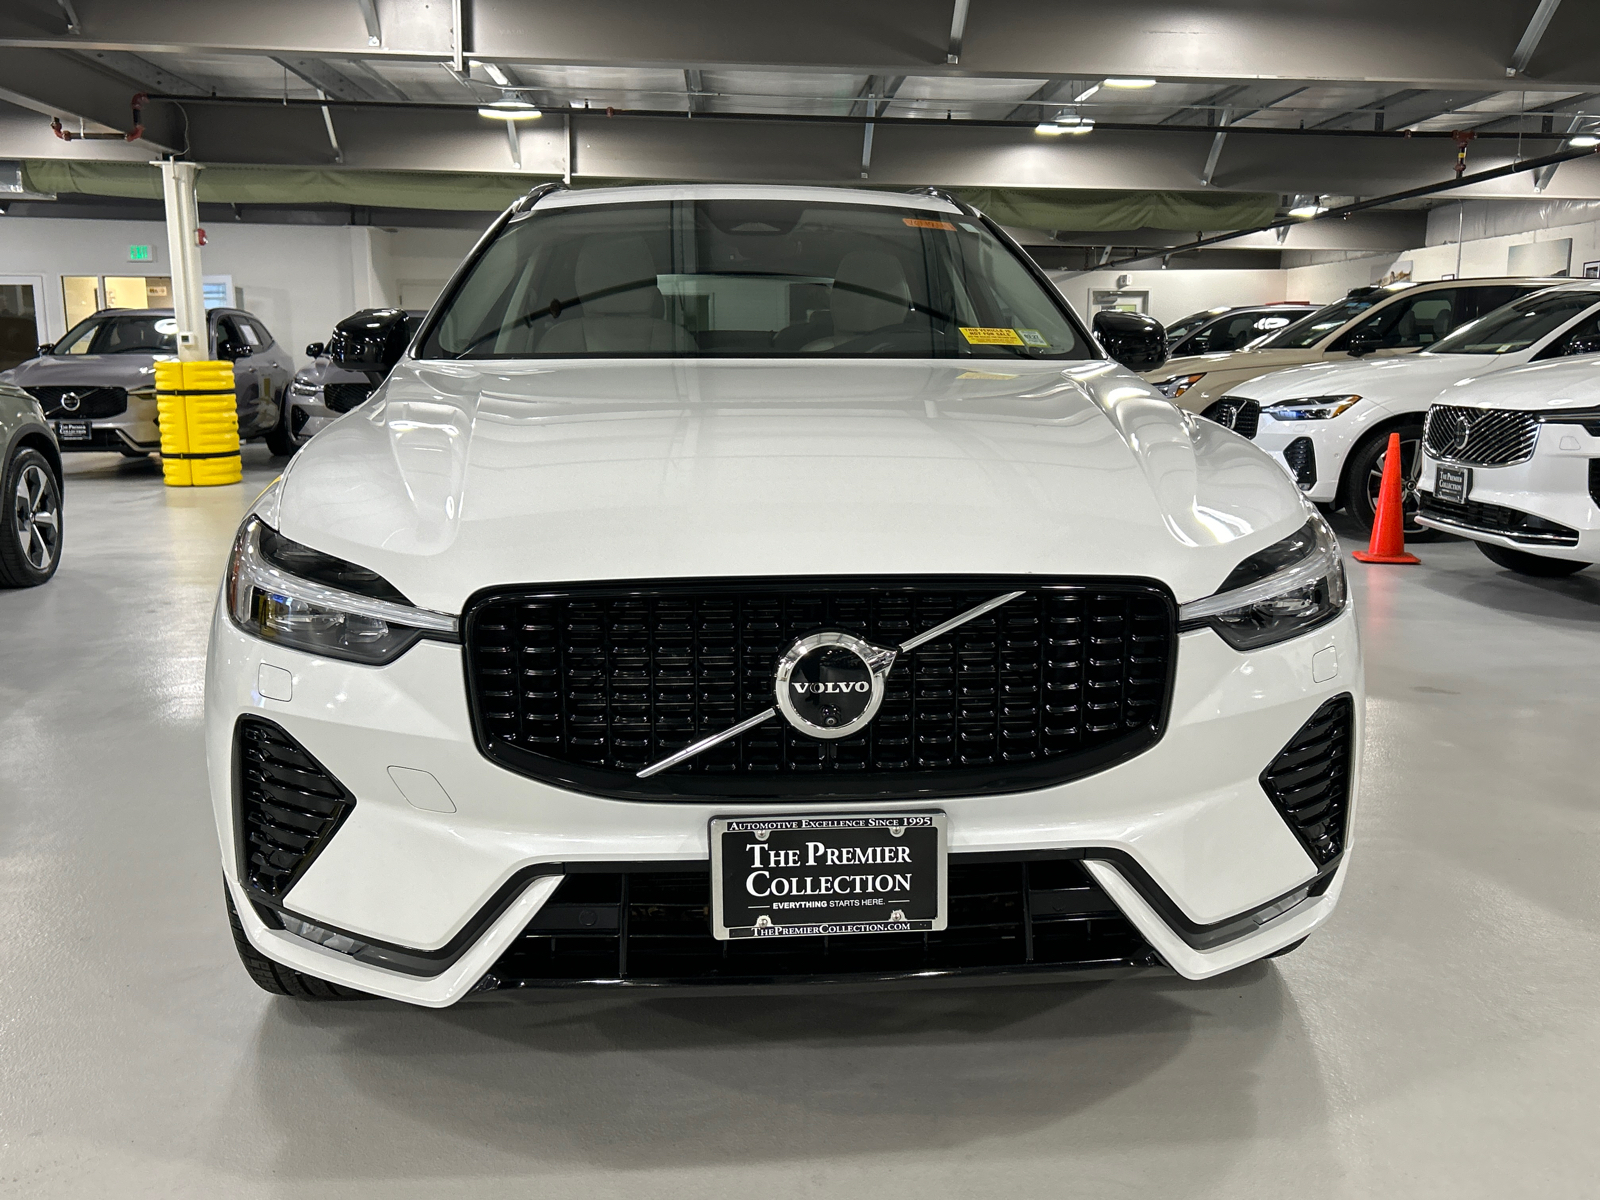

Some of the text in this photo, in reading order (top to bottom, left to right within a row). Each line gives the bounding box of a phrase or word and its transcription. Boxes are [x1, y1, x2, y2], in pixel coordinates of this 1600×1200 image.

[129, 245, 148, 260] EXIT
[791, 681, 870, 694] VOLVO
[902, 817, 932, 827] 1995
[772, 898, 886, 910] EVERYTHING STARTS HERE.
